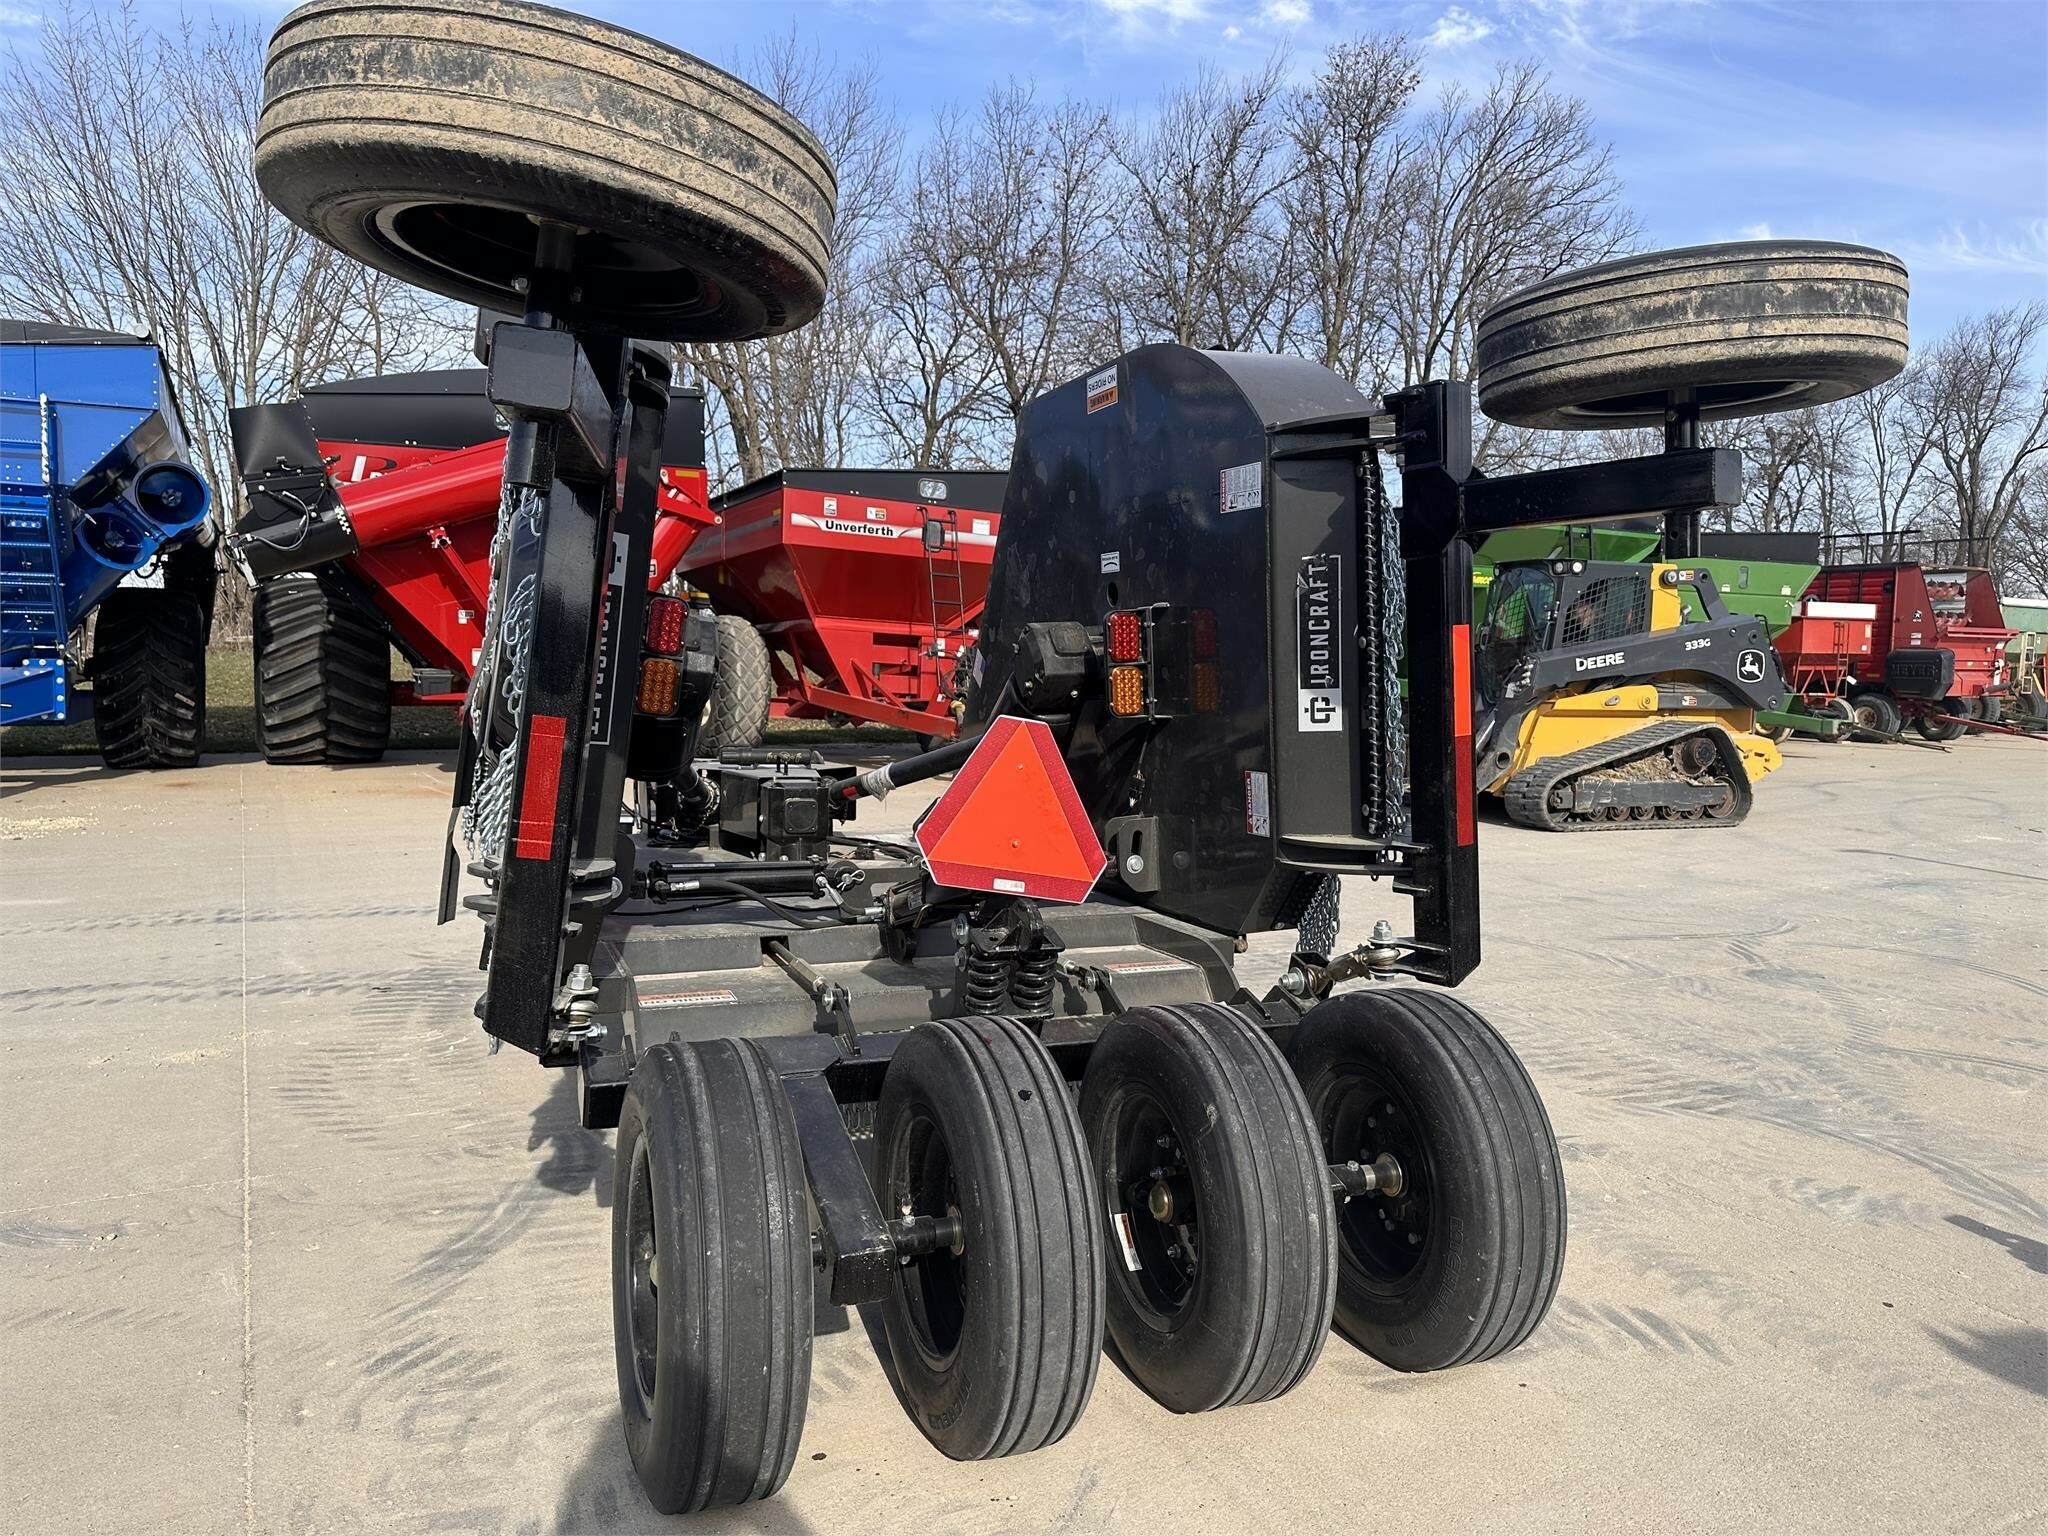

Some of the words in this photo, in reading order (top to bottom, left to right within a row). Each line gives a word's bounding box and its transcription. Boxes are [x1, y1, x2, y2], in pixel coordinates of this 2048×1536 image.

[1107, 373, 1116, 384] NO
[825, 519, 894, 537] Unverferth
[1308, 563, 1333, 688] IRONCRAFT
[1684, 638, 1711, 651] 333G
[1575, 651, 1625, 672] DEERE
